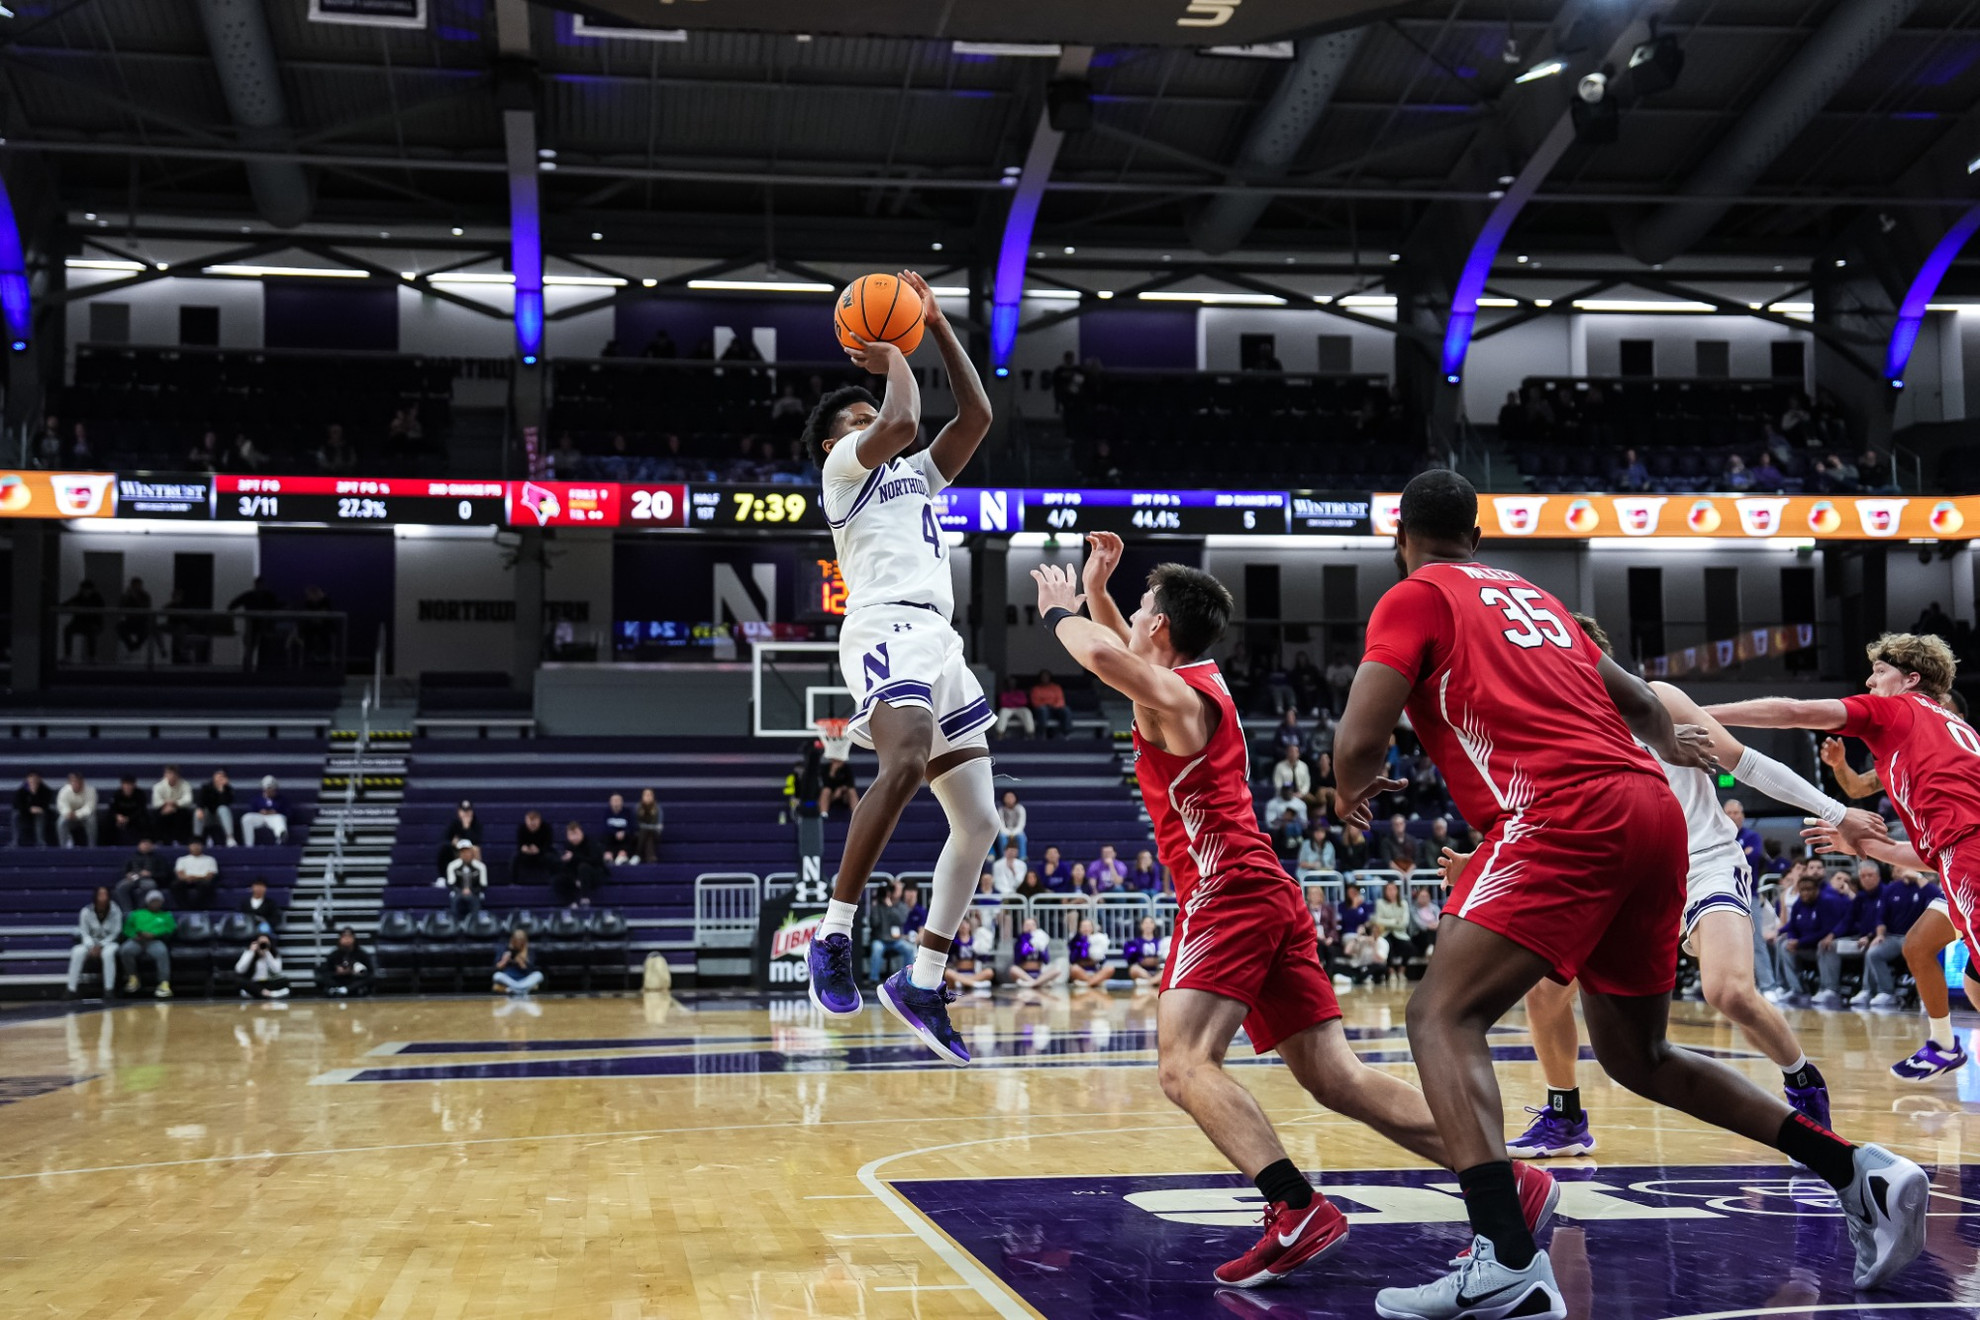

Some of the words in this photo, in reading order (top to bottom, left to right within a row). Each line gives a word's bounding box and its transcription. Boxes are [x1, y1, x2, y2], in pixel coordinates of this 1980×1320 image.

[120, 480, 206, 498] WINTRUST
[878, 478, 930, 504] NORTHW
[239, 496, 278, 517] 3/11
[338, 498, 387, 518] 27.3%
[458, 500, 472, 520] 0
[631, 490, 673, 520] 20
[734, 493, 806, 522] 7:39
[980, 490, 1007, 531] N
[1293, 498, 1369, 515] WINTRUST
[1047, 508, 1077, 529] 4/9
[1131, 509, 1181, 529] 44.4%
[1243, 510, 1256, 530] 5
[922, 503, 941, 559] 4
[817, 559, 841, 578] 7:3
[821, 580, 849, 615] 12
[418, 599, 590, 622] NORTHWERN
[712, 562, 777, 660] N
[1479, 586, 1573, 649] 35
[862, 641, 890, 692] N
[802, 855, 821, 882] N
[775, 926, 816, 956] LIBM
[769, 960, 810, 983] me
